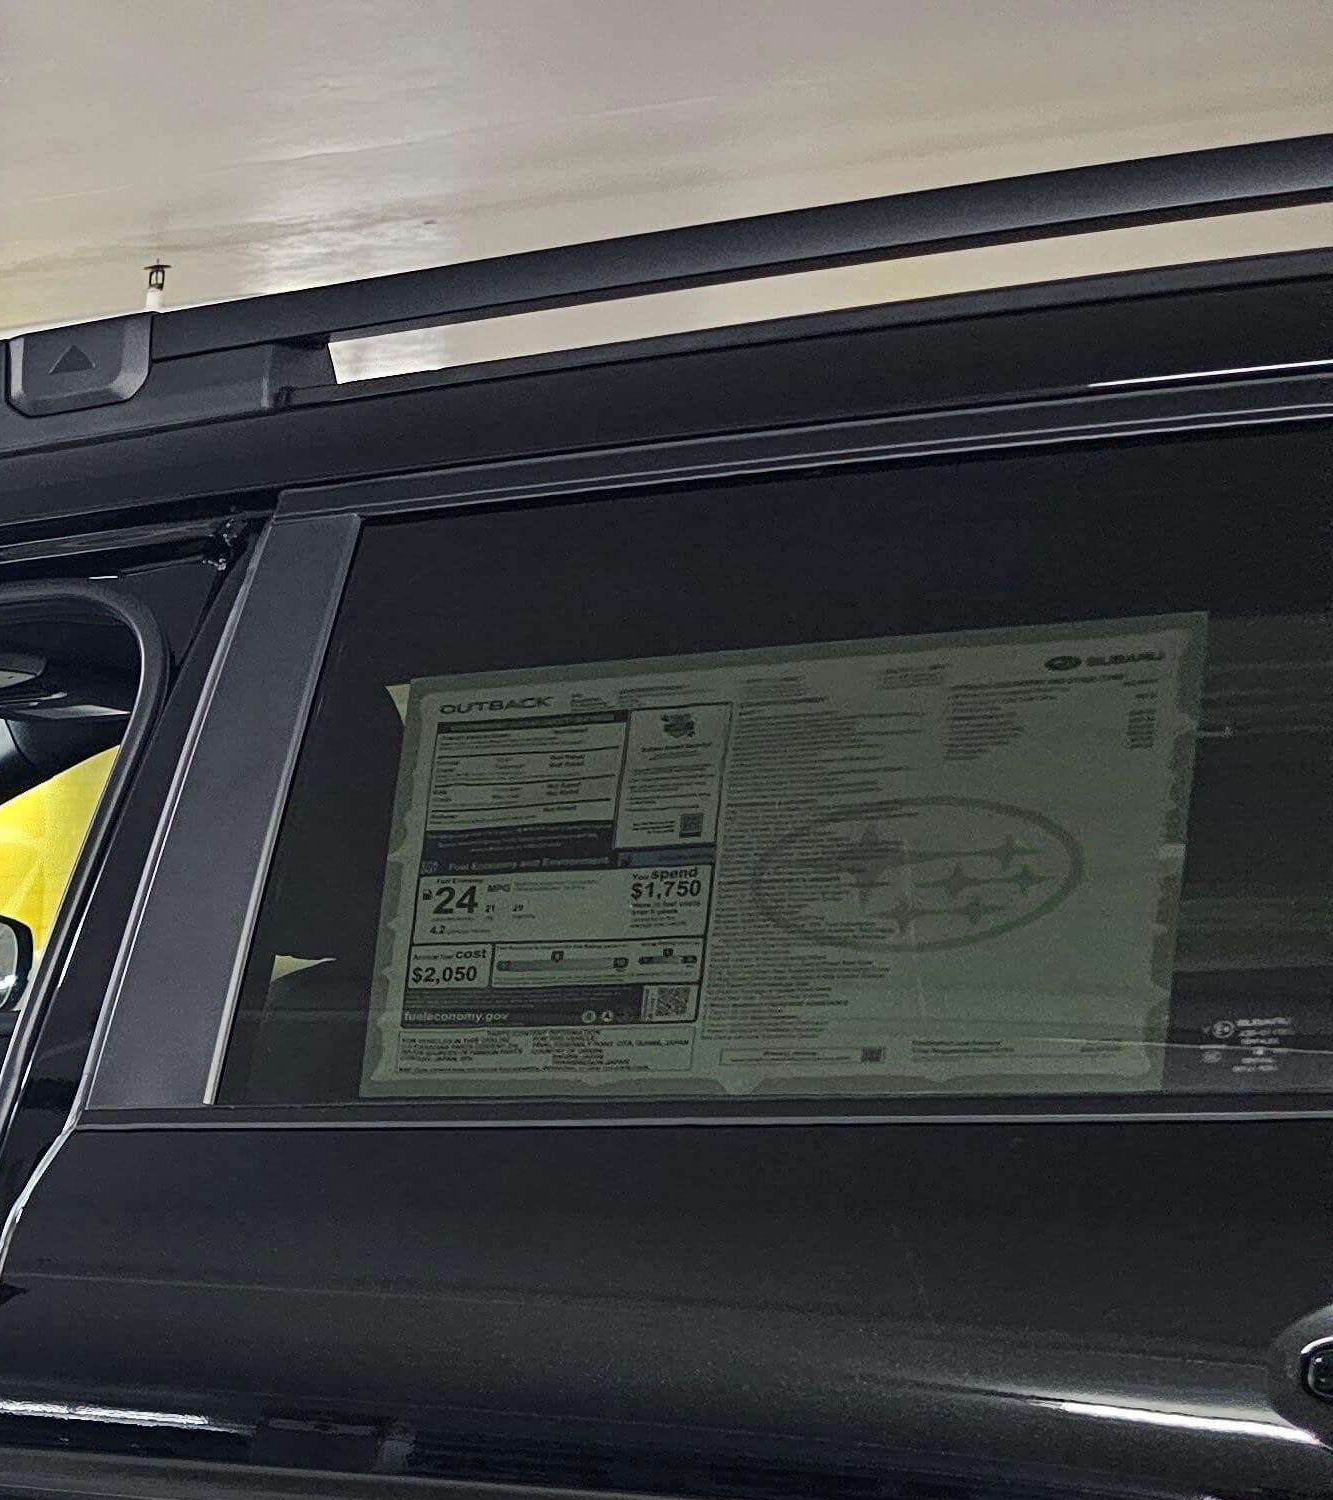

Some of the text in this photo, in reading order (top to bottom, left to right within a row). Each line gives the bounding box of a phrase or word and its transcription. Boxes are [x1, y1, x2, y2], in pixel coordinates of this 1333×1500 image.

[439, 696, 554, 714] OUTBACK
[651, 866, 699, 881] spend
[487, 884, 511, 893] MPG
[630, 880, 702, 900] $1,750
[433, 885, 478, 914] 24
[484, 903, 496, 913] 21
[455, 948, 488, 959] cost
[412, 965, 478, 984] $2,050
[405, 1011, 510, 1023] fueleconomy.gov
